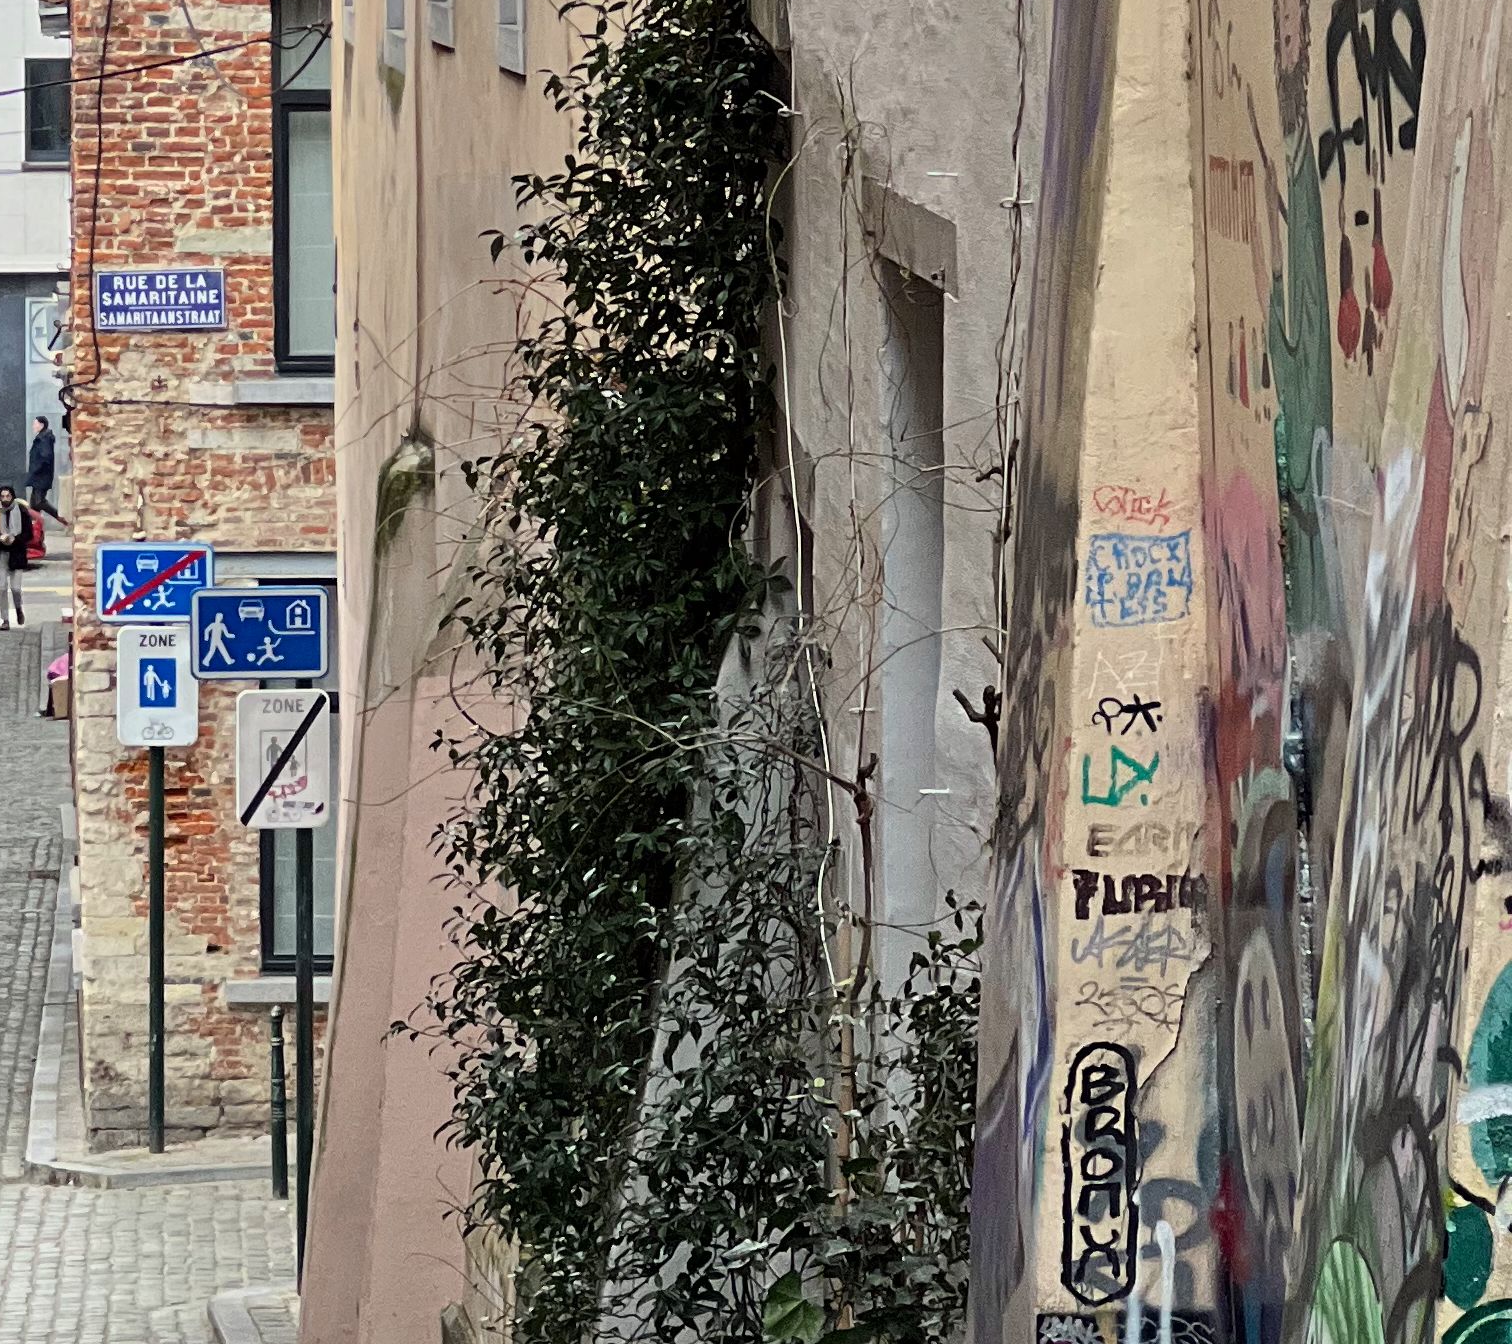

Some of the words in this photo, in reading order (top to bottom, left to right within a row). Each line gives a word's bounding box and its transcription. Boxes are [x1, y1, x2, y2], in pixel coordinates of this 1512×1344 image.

[113, 275, 148, 290] RUE
[155, 274, 179, 289] DE
[185, 273, 207, 288] LA
[102, 289, 220, 306] SAMARITAINE
[100, 309, 221, 326] SAMARITAANSTRAAT
[139, 634, 177, 648] ZONE
[262, 698, 305, 714] ZONE
[1074, 1063, 1126, 1284] BRONX
